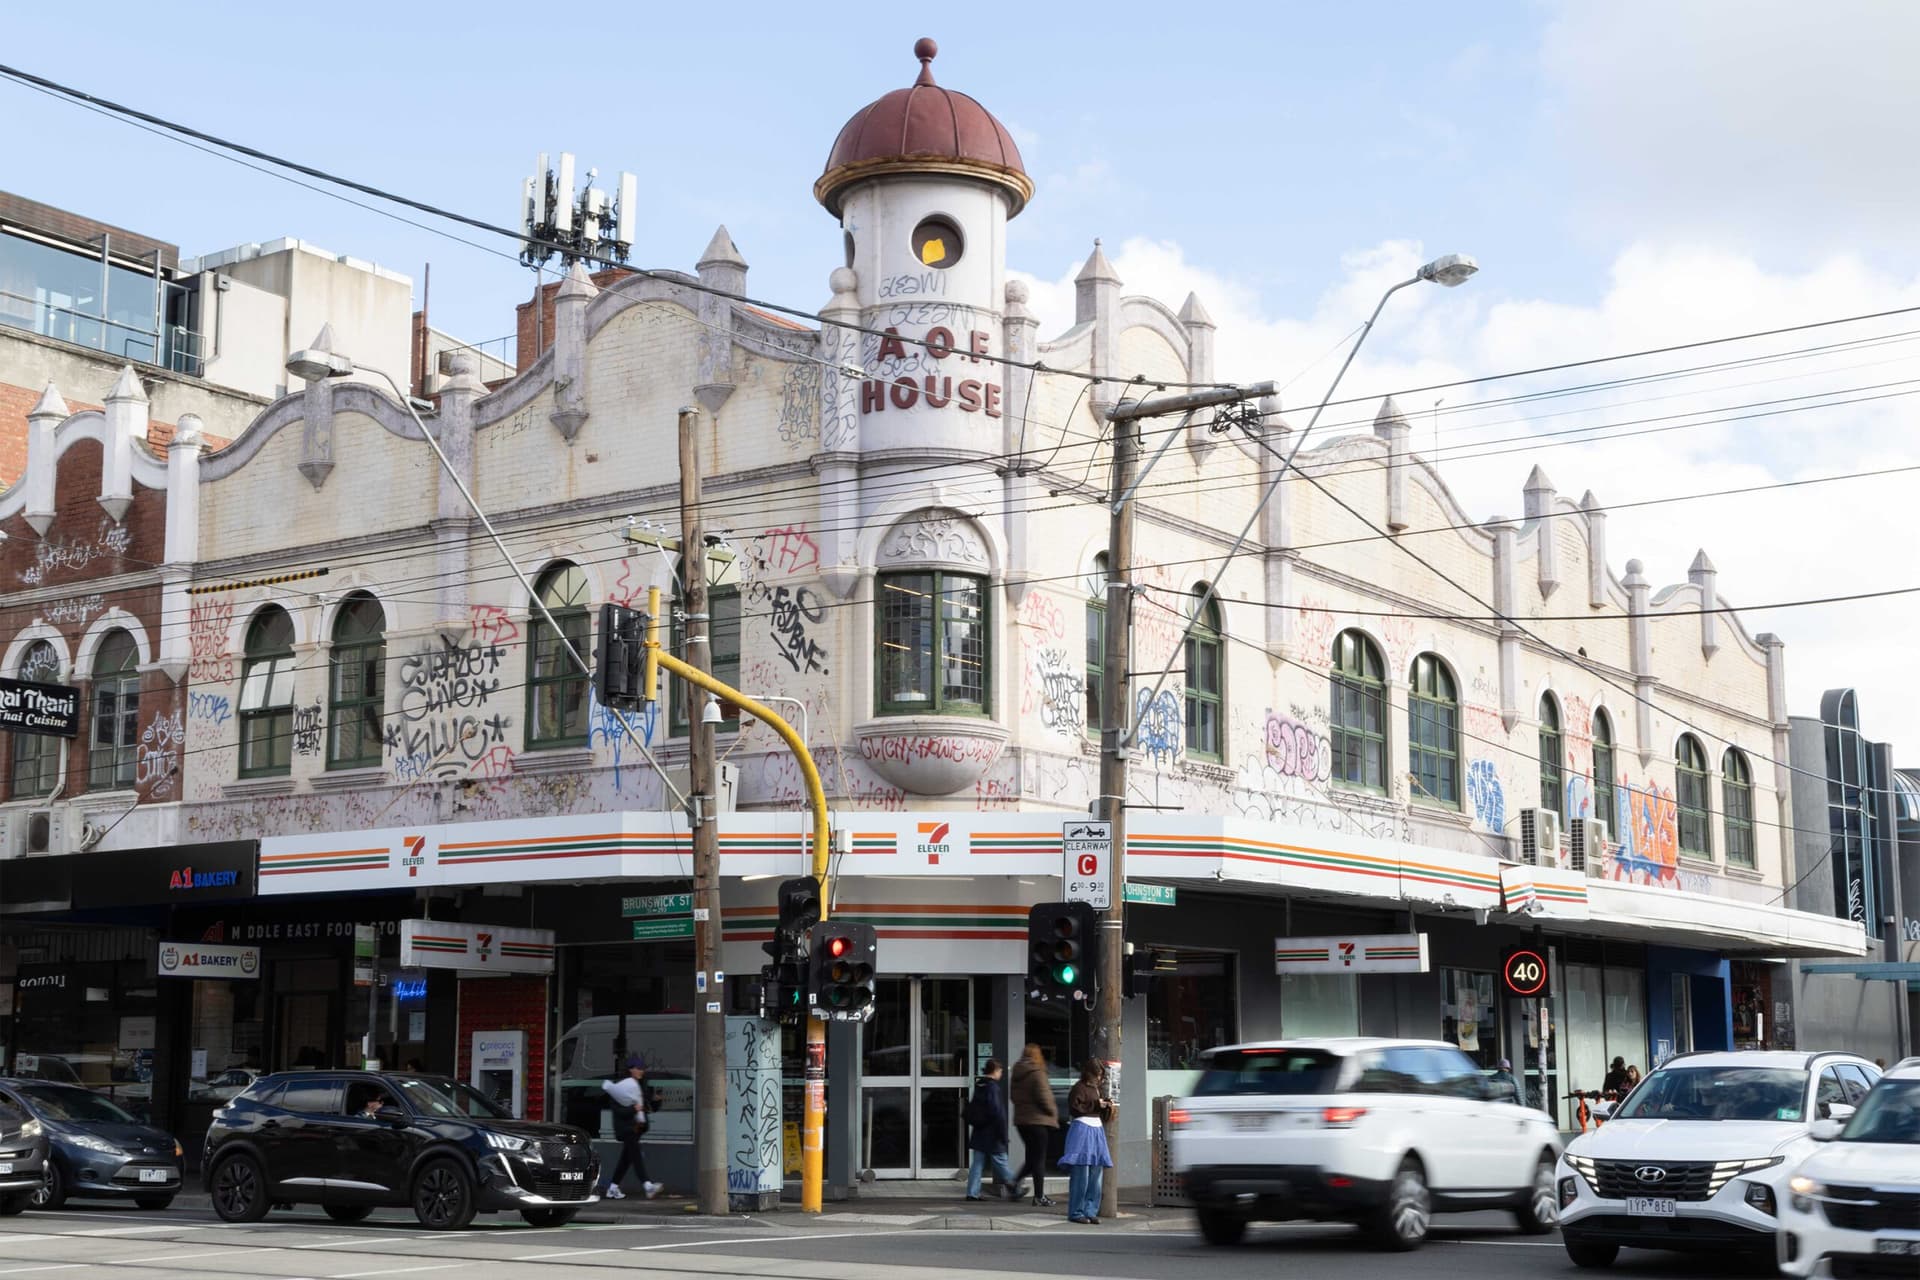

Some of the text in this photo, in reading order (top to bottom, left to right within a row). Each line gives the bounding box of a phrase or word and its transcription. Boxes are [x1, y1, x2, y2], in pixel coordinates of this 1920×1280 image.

[862, 375, 1002, 418] HOUSE
[23, 688, 75, 717] Thani
[25, 713, 69, 729] Cuisine
[1065, 841, 1110, 851] CLEARWAY
[1080, 855, 1094, 875] C
[169, 866, 238, 889] A1 BAKERY
[1164, 888, 1175, 899] ST
[623, 895, 691, 910] BRUNSWICK ST
[286, 922, 321, 938] EAST
[326, 921, 361, 938] FOO
[182, 951, 239, 968] A1 BAKERY
[1512, 962, 1540, 982] 40
